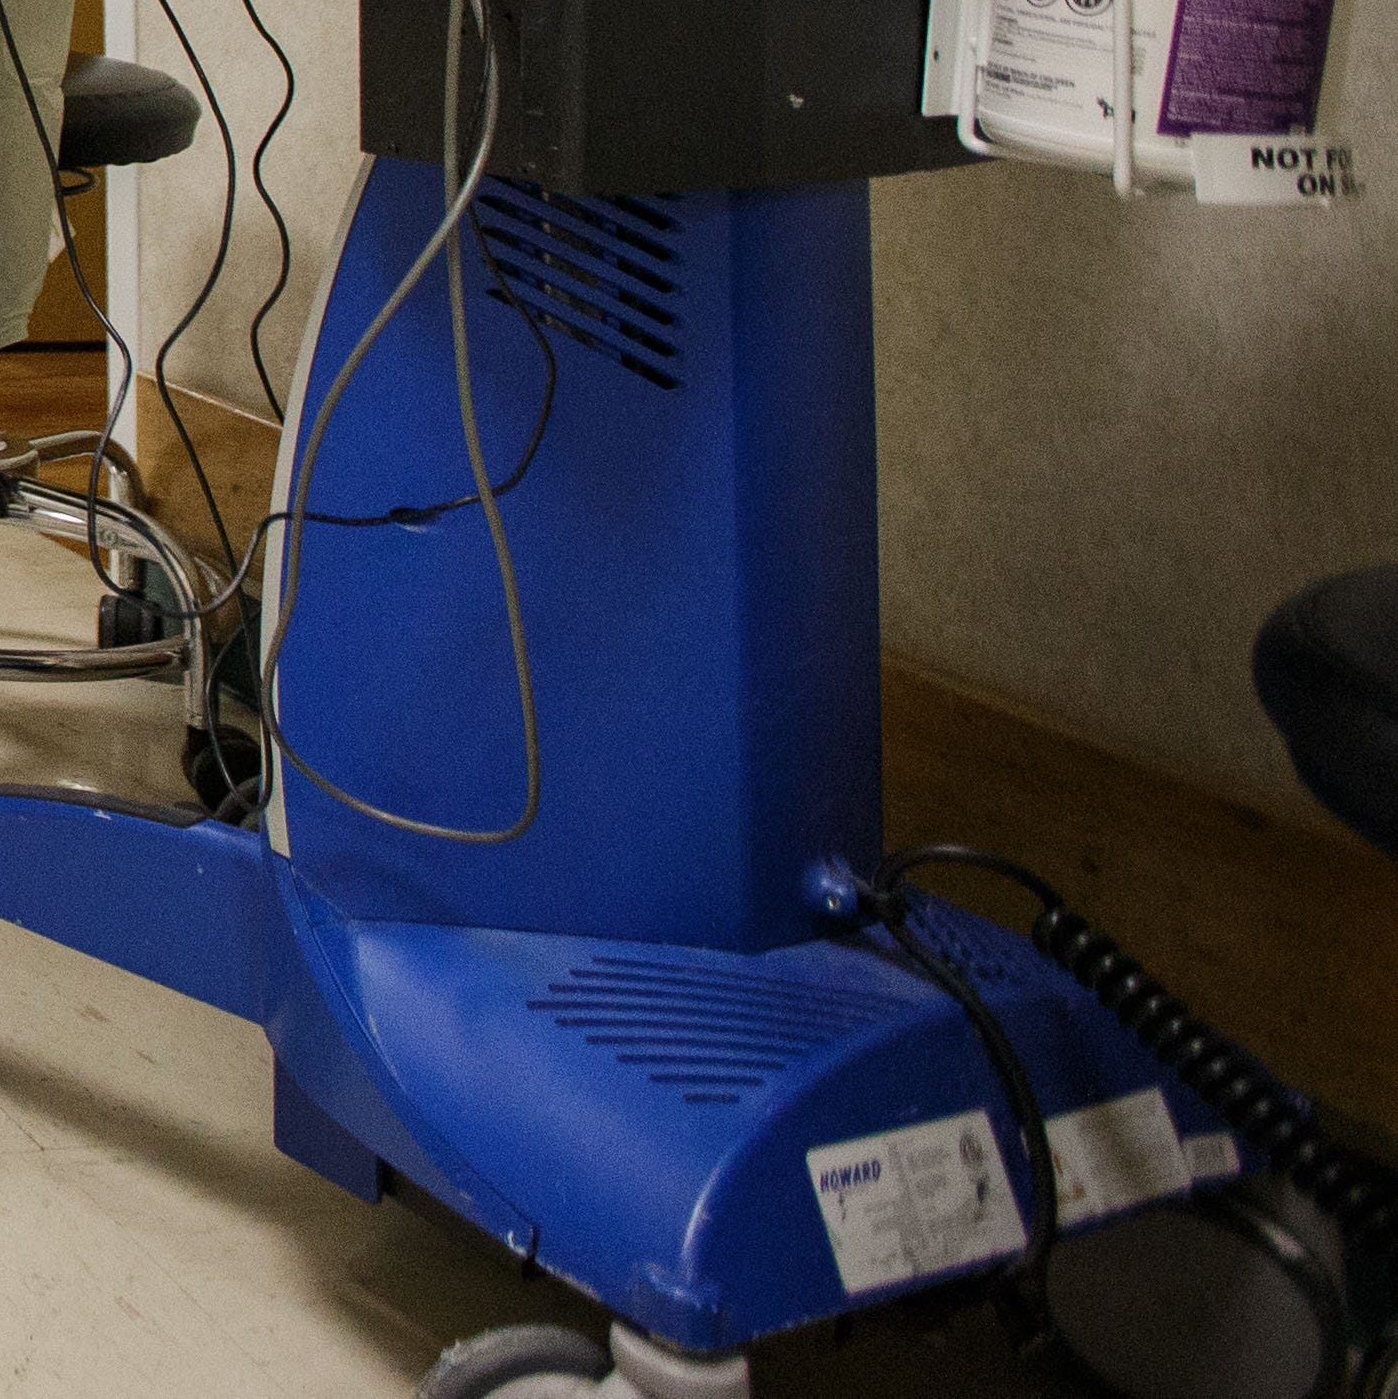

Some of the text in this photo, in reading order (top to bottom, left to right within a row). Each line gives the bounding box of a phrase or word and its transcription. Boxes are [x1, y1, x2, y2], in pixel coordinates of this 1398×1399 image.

[1251, 147, 1316, 171] NOT
[1297, 174, 1335, 197] ON
[819, 1159, 882, 1194] HOWARD
